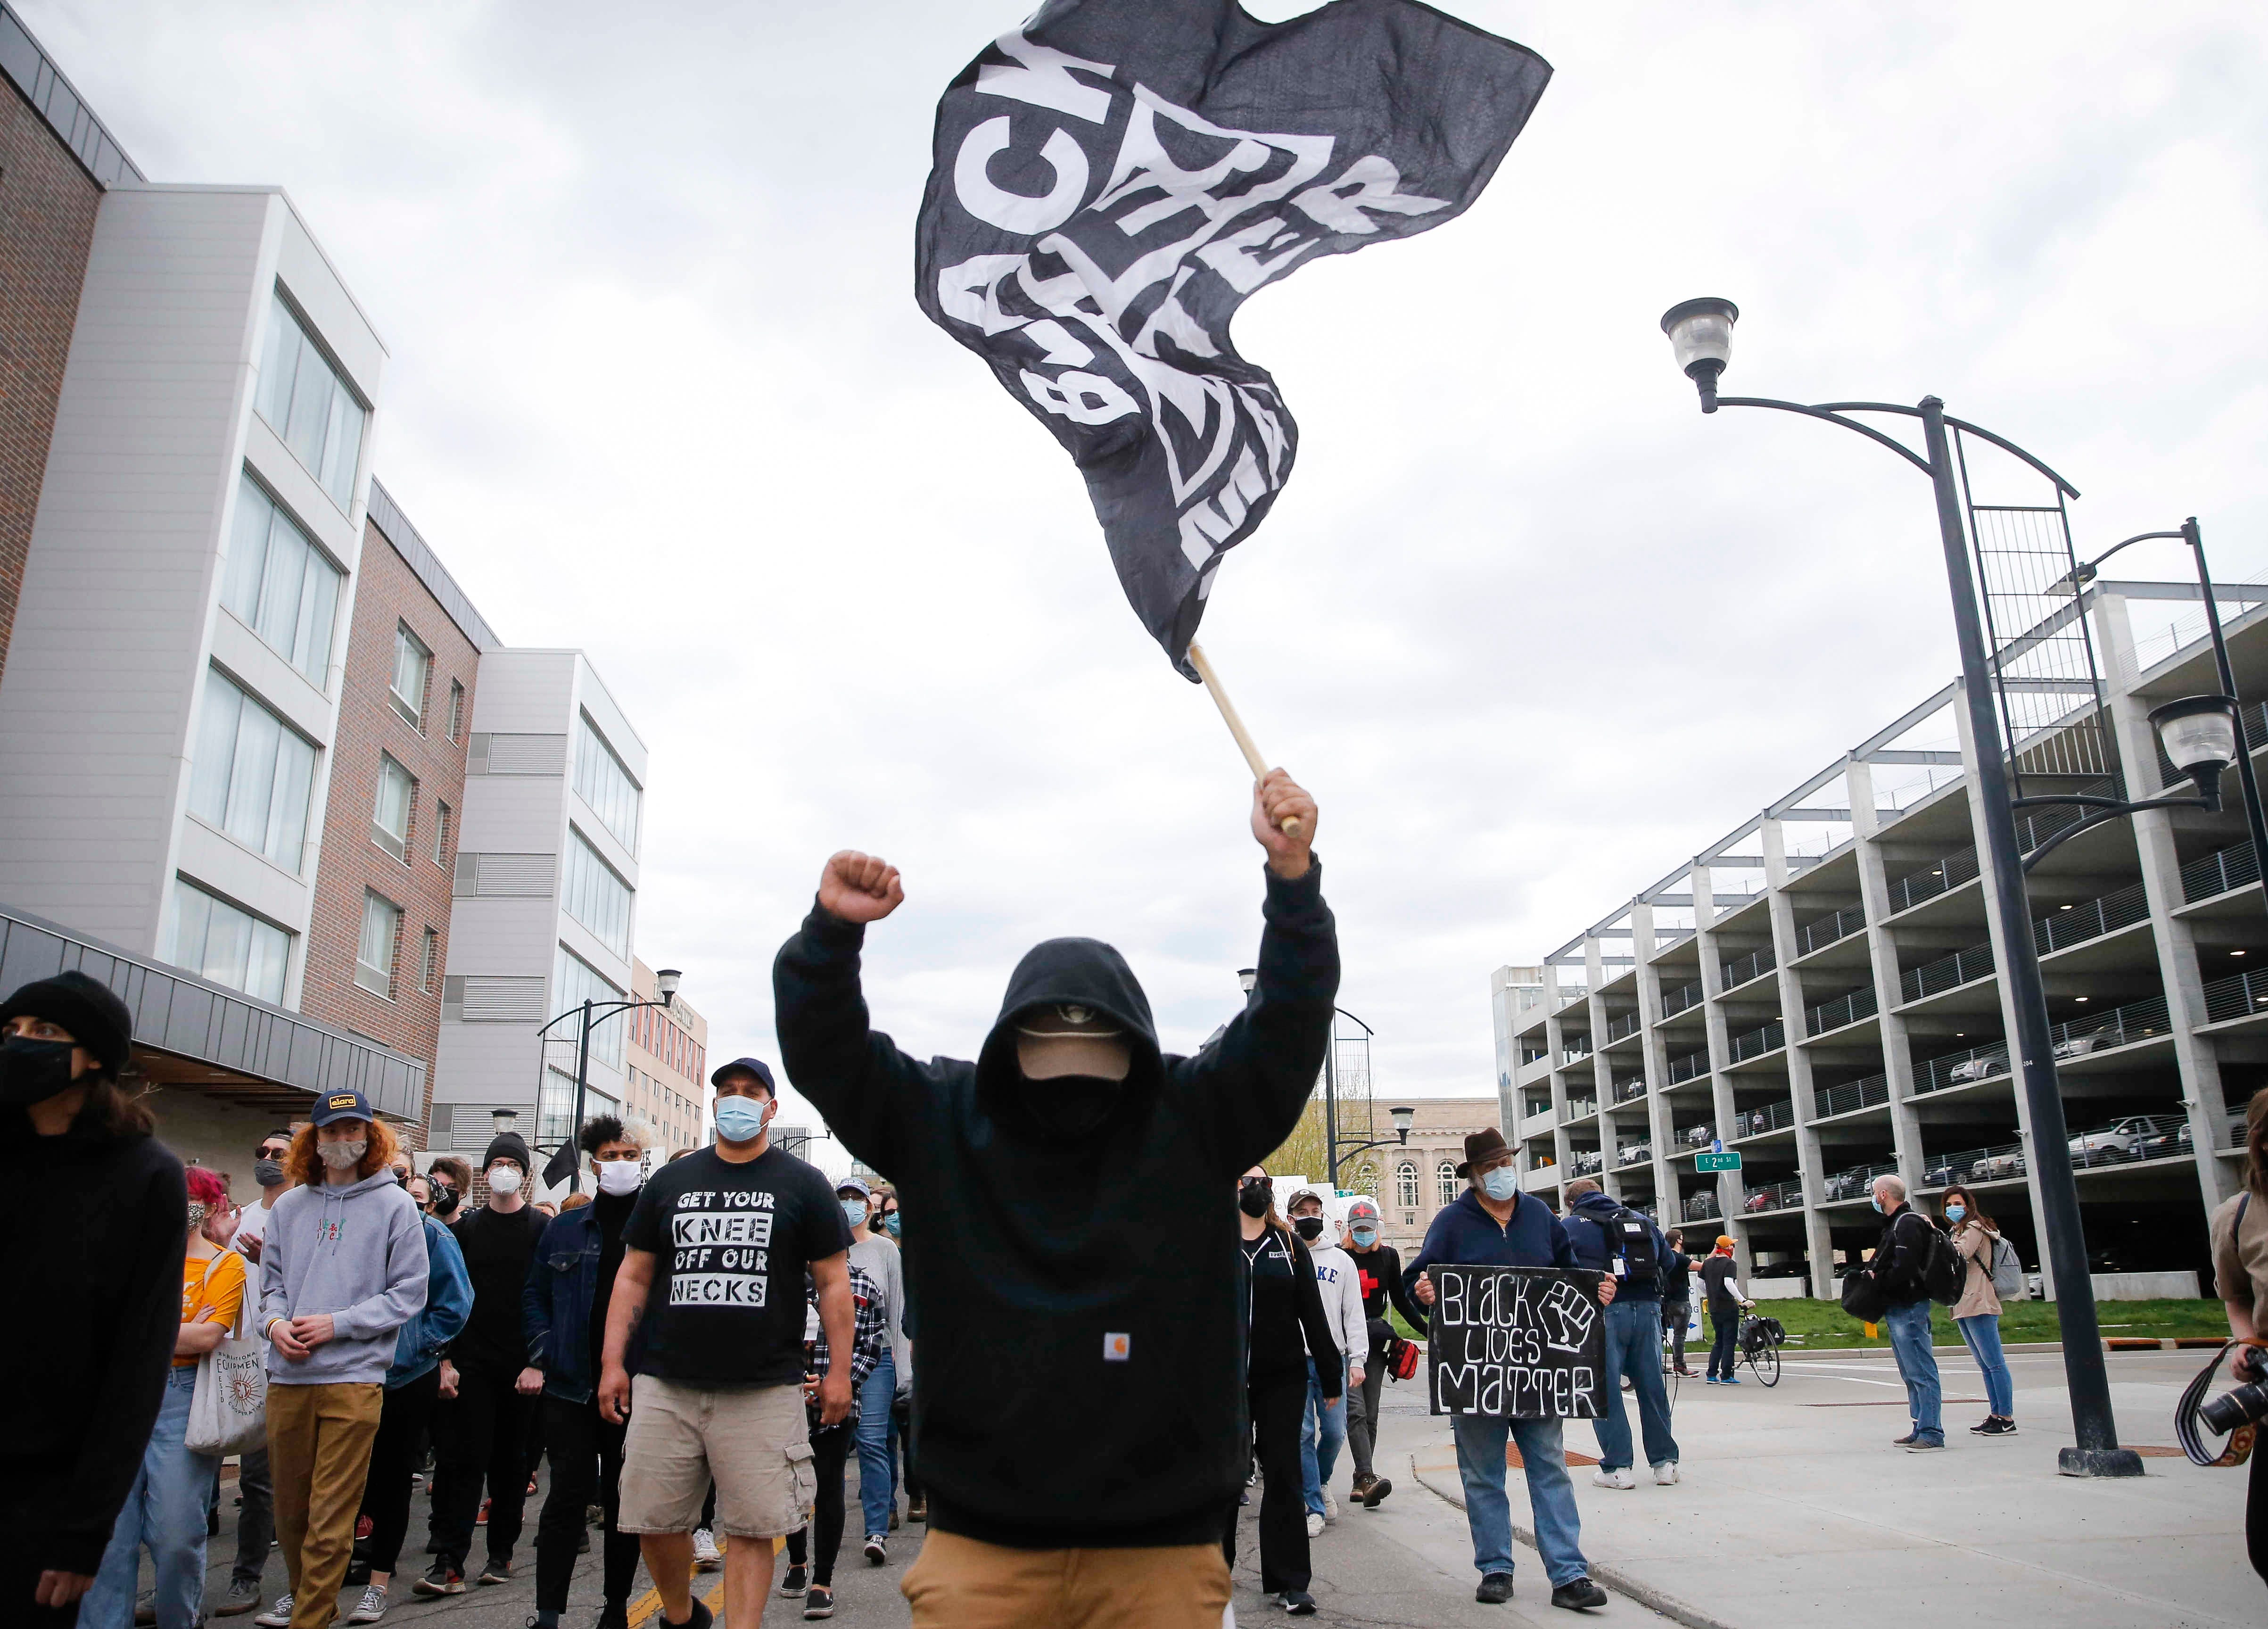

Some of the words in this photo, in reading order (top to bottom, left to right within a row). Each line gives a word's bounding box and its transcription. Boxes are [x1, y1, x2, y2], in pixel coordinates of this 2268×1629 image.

[677, 1191, 716, 1208] GET
[723, 1191, 775, 1209] YOUR
[675, 1218, 768, 1243] KNEE
[675, 1248, 712, 1270] OFF
[722, 1249, 767, 1271] OUR
[671, 1278, 763, 1303] NECKS
